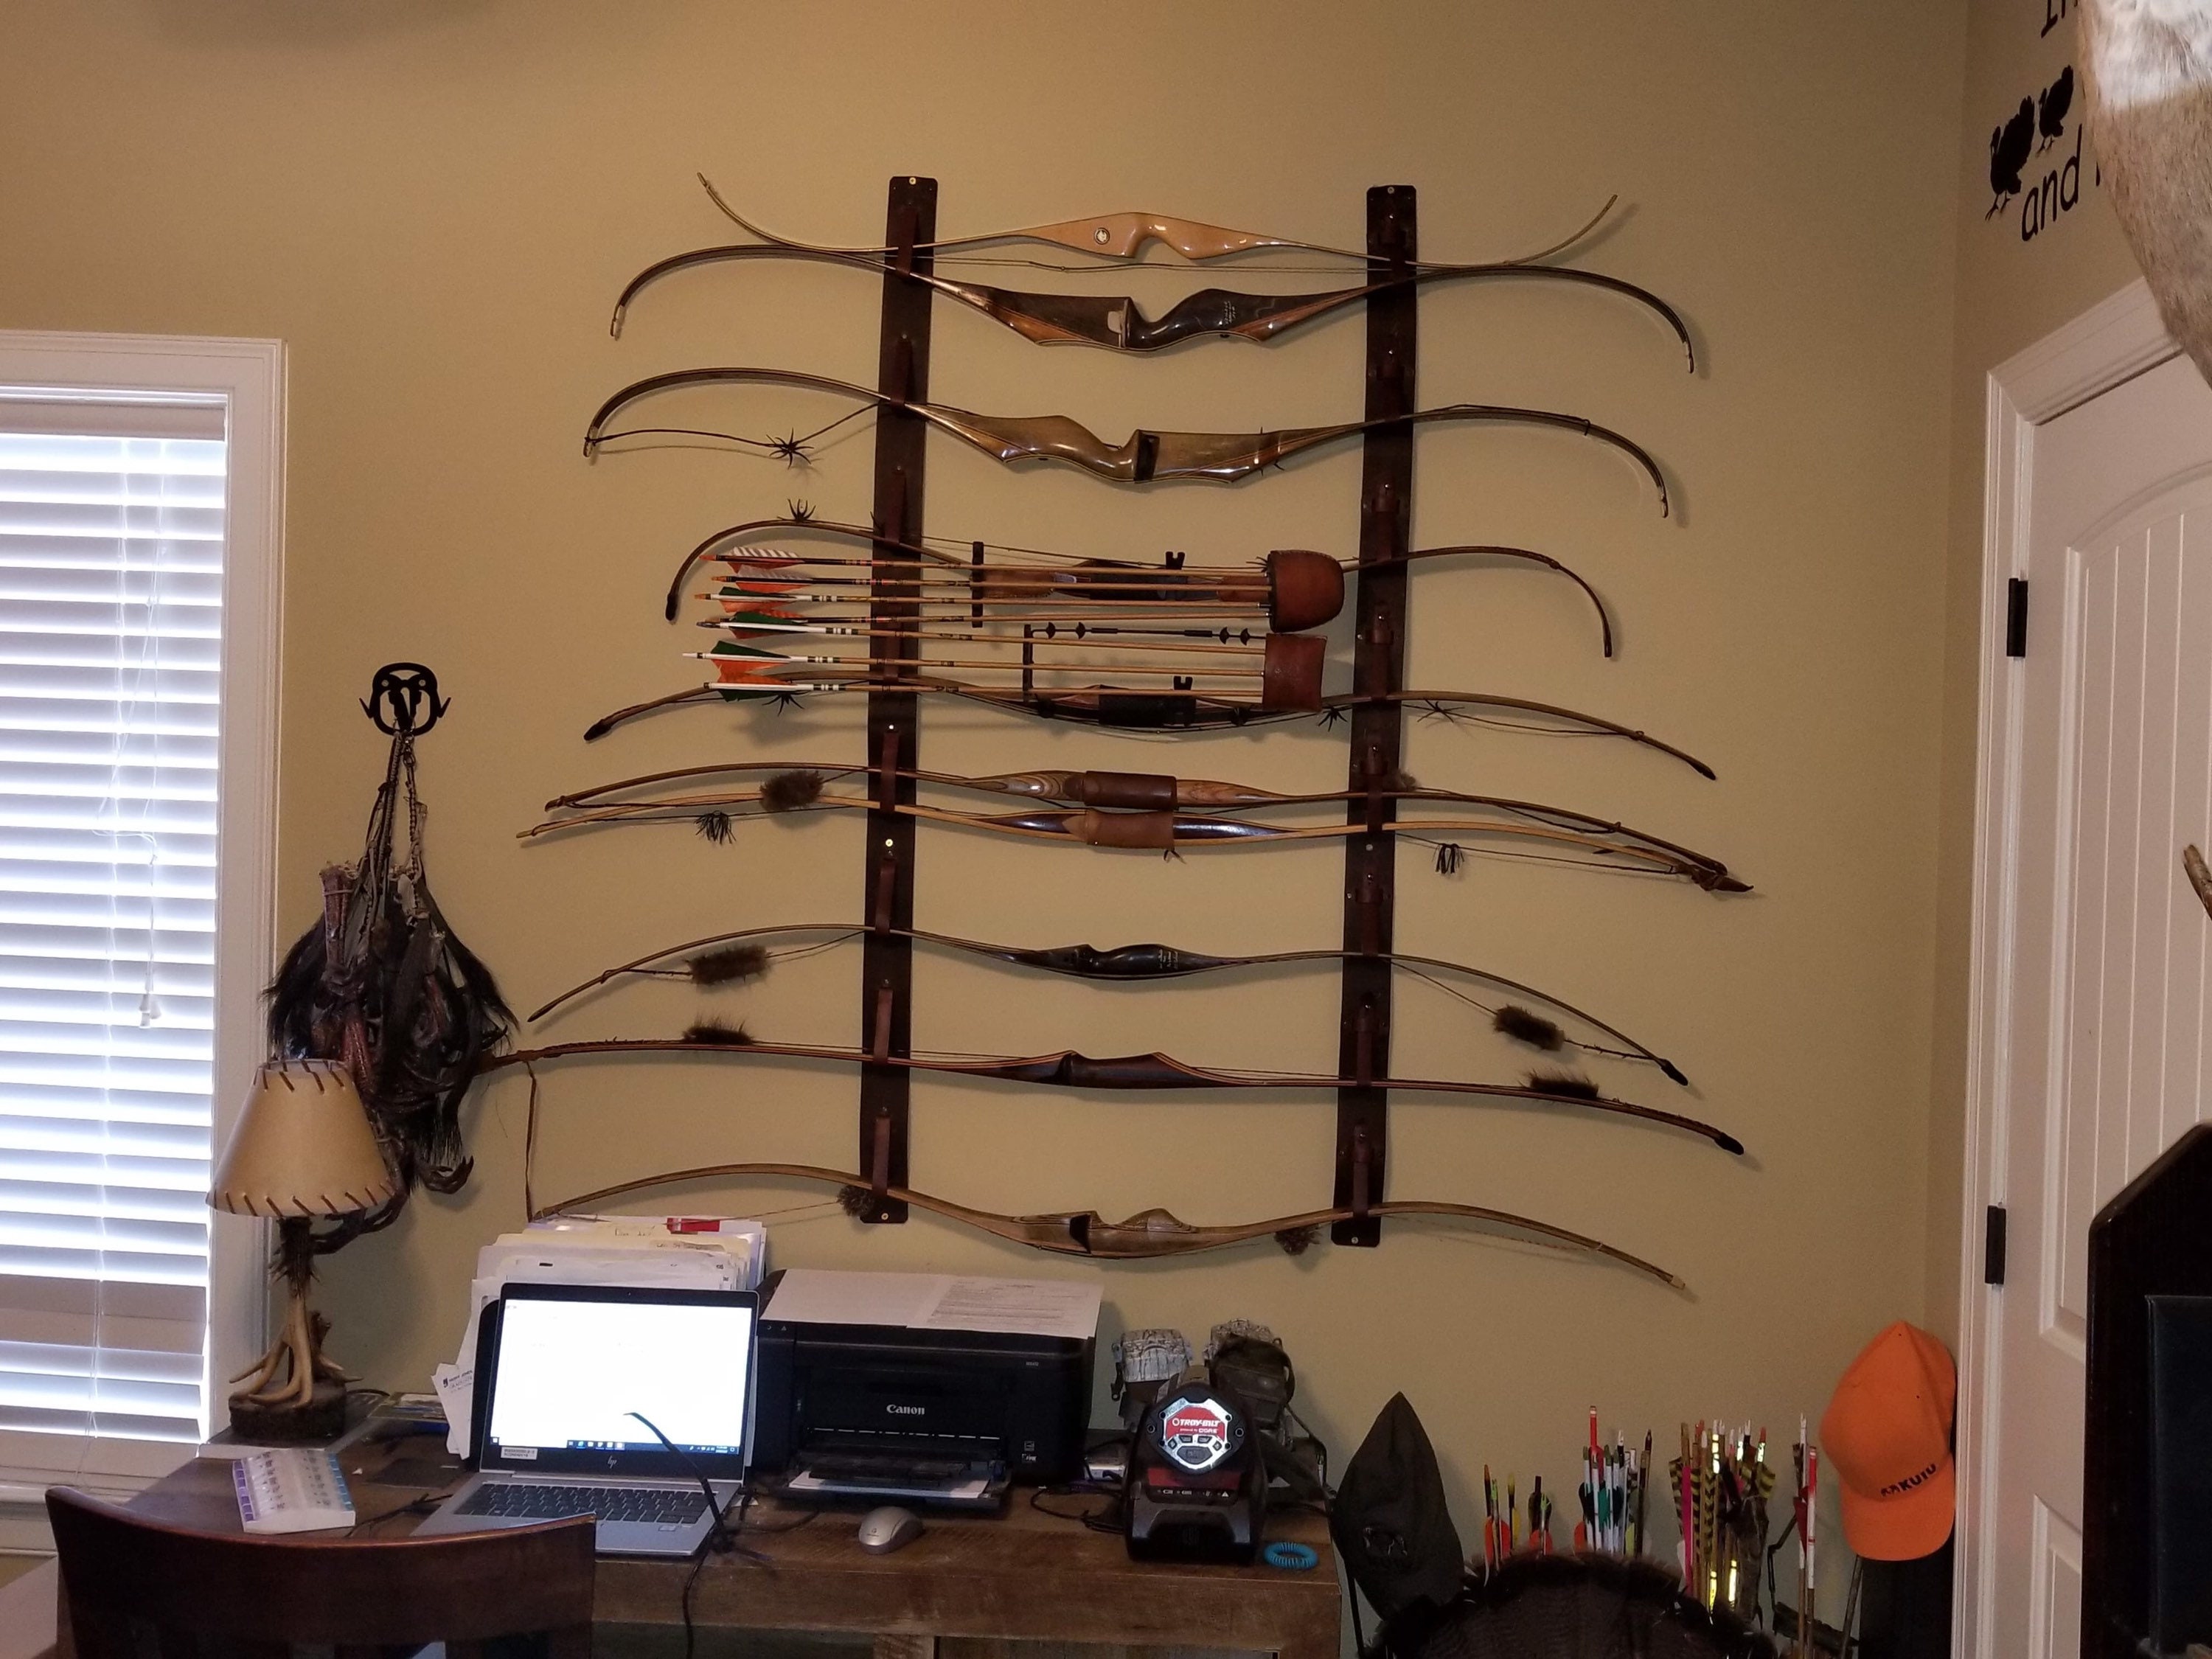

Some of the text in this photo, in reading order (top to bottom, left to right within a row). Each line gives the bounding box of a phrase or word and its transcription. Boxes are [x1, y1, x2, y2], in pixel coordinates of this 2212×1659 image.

[2022, 123, 2083, 242] and
[886, 1404, 925, 1416] Canon
[1180, 1419, 1221, 1427] TROY-BILT
[1898, 1464, 1937, 1491] KUIU
